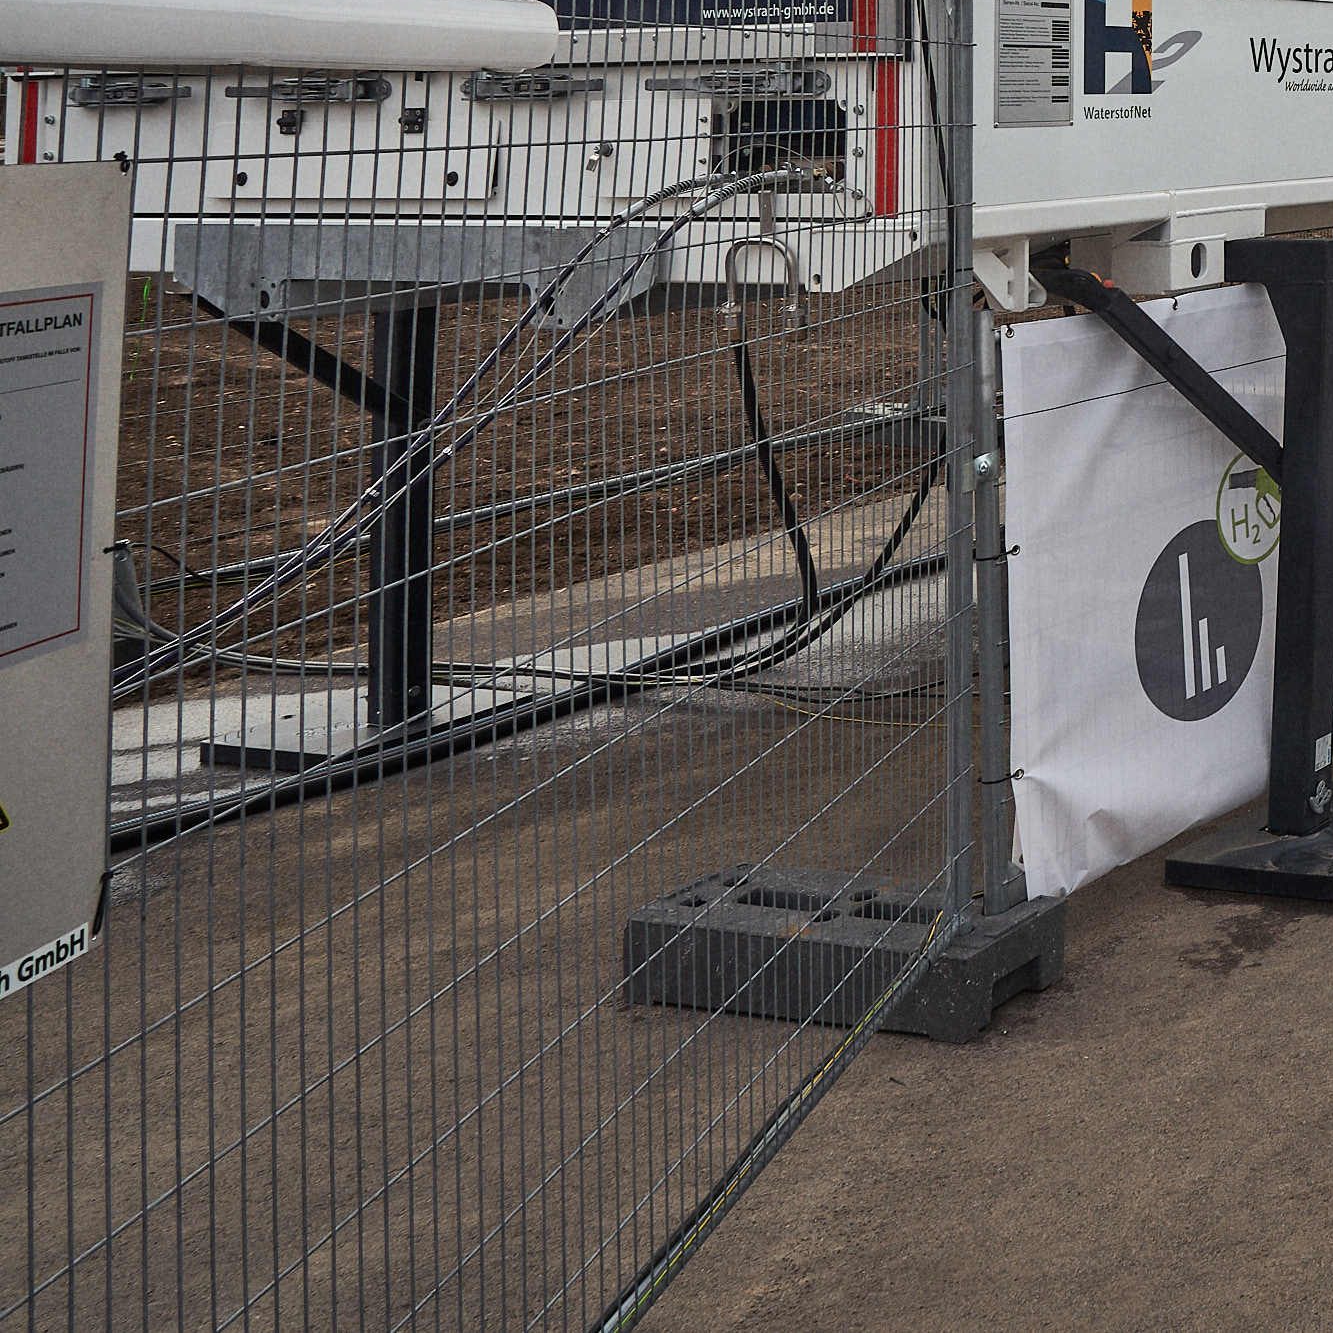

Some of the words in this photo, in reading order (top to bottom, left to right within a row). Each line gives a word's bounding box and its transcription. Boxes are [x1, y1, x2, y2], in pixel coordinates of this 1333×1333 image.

[702, 2, 835, 20] www.wystrach-gmbh.de
[1285, 79, 1327, 92] Worldwide
[1083, 105, 1153, 120] WaterstofNet
[17, 928, 85, 982] GmbH
